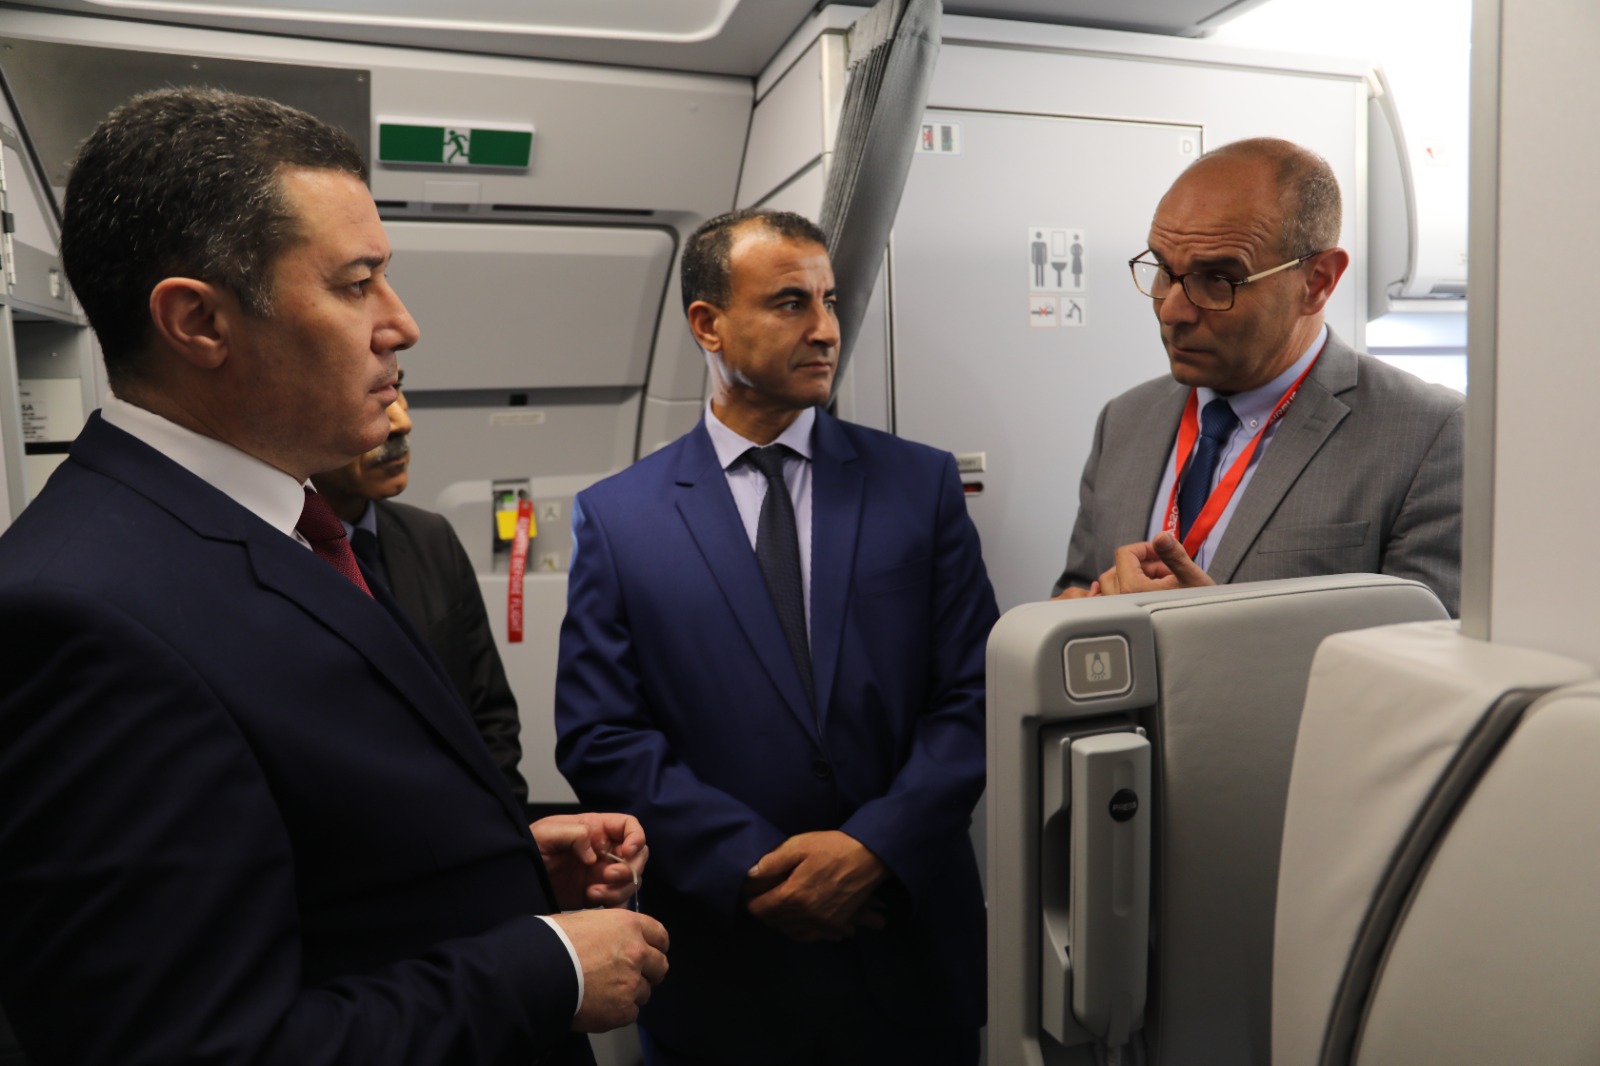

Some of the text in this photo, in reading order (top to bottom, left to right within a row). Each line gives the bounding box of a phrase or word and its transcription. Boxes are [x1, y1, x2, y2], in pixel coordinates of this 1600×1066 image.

[1182, 139, 1192, 154] D
[510, 557, 524, 594] BEFORE
[510, 598, 522, 631] FLIGHT
